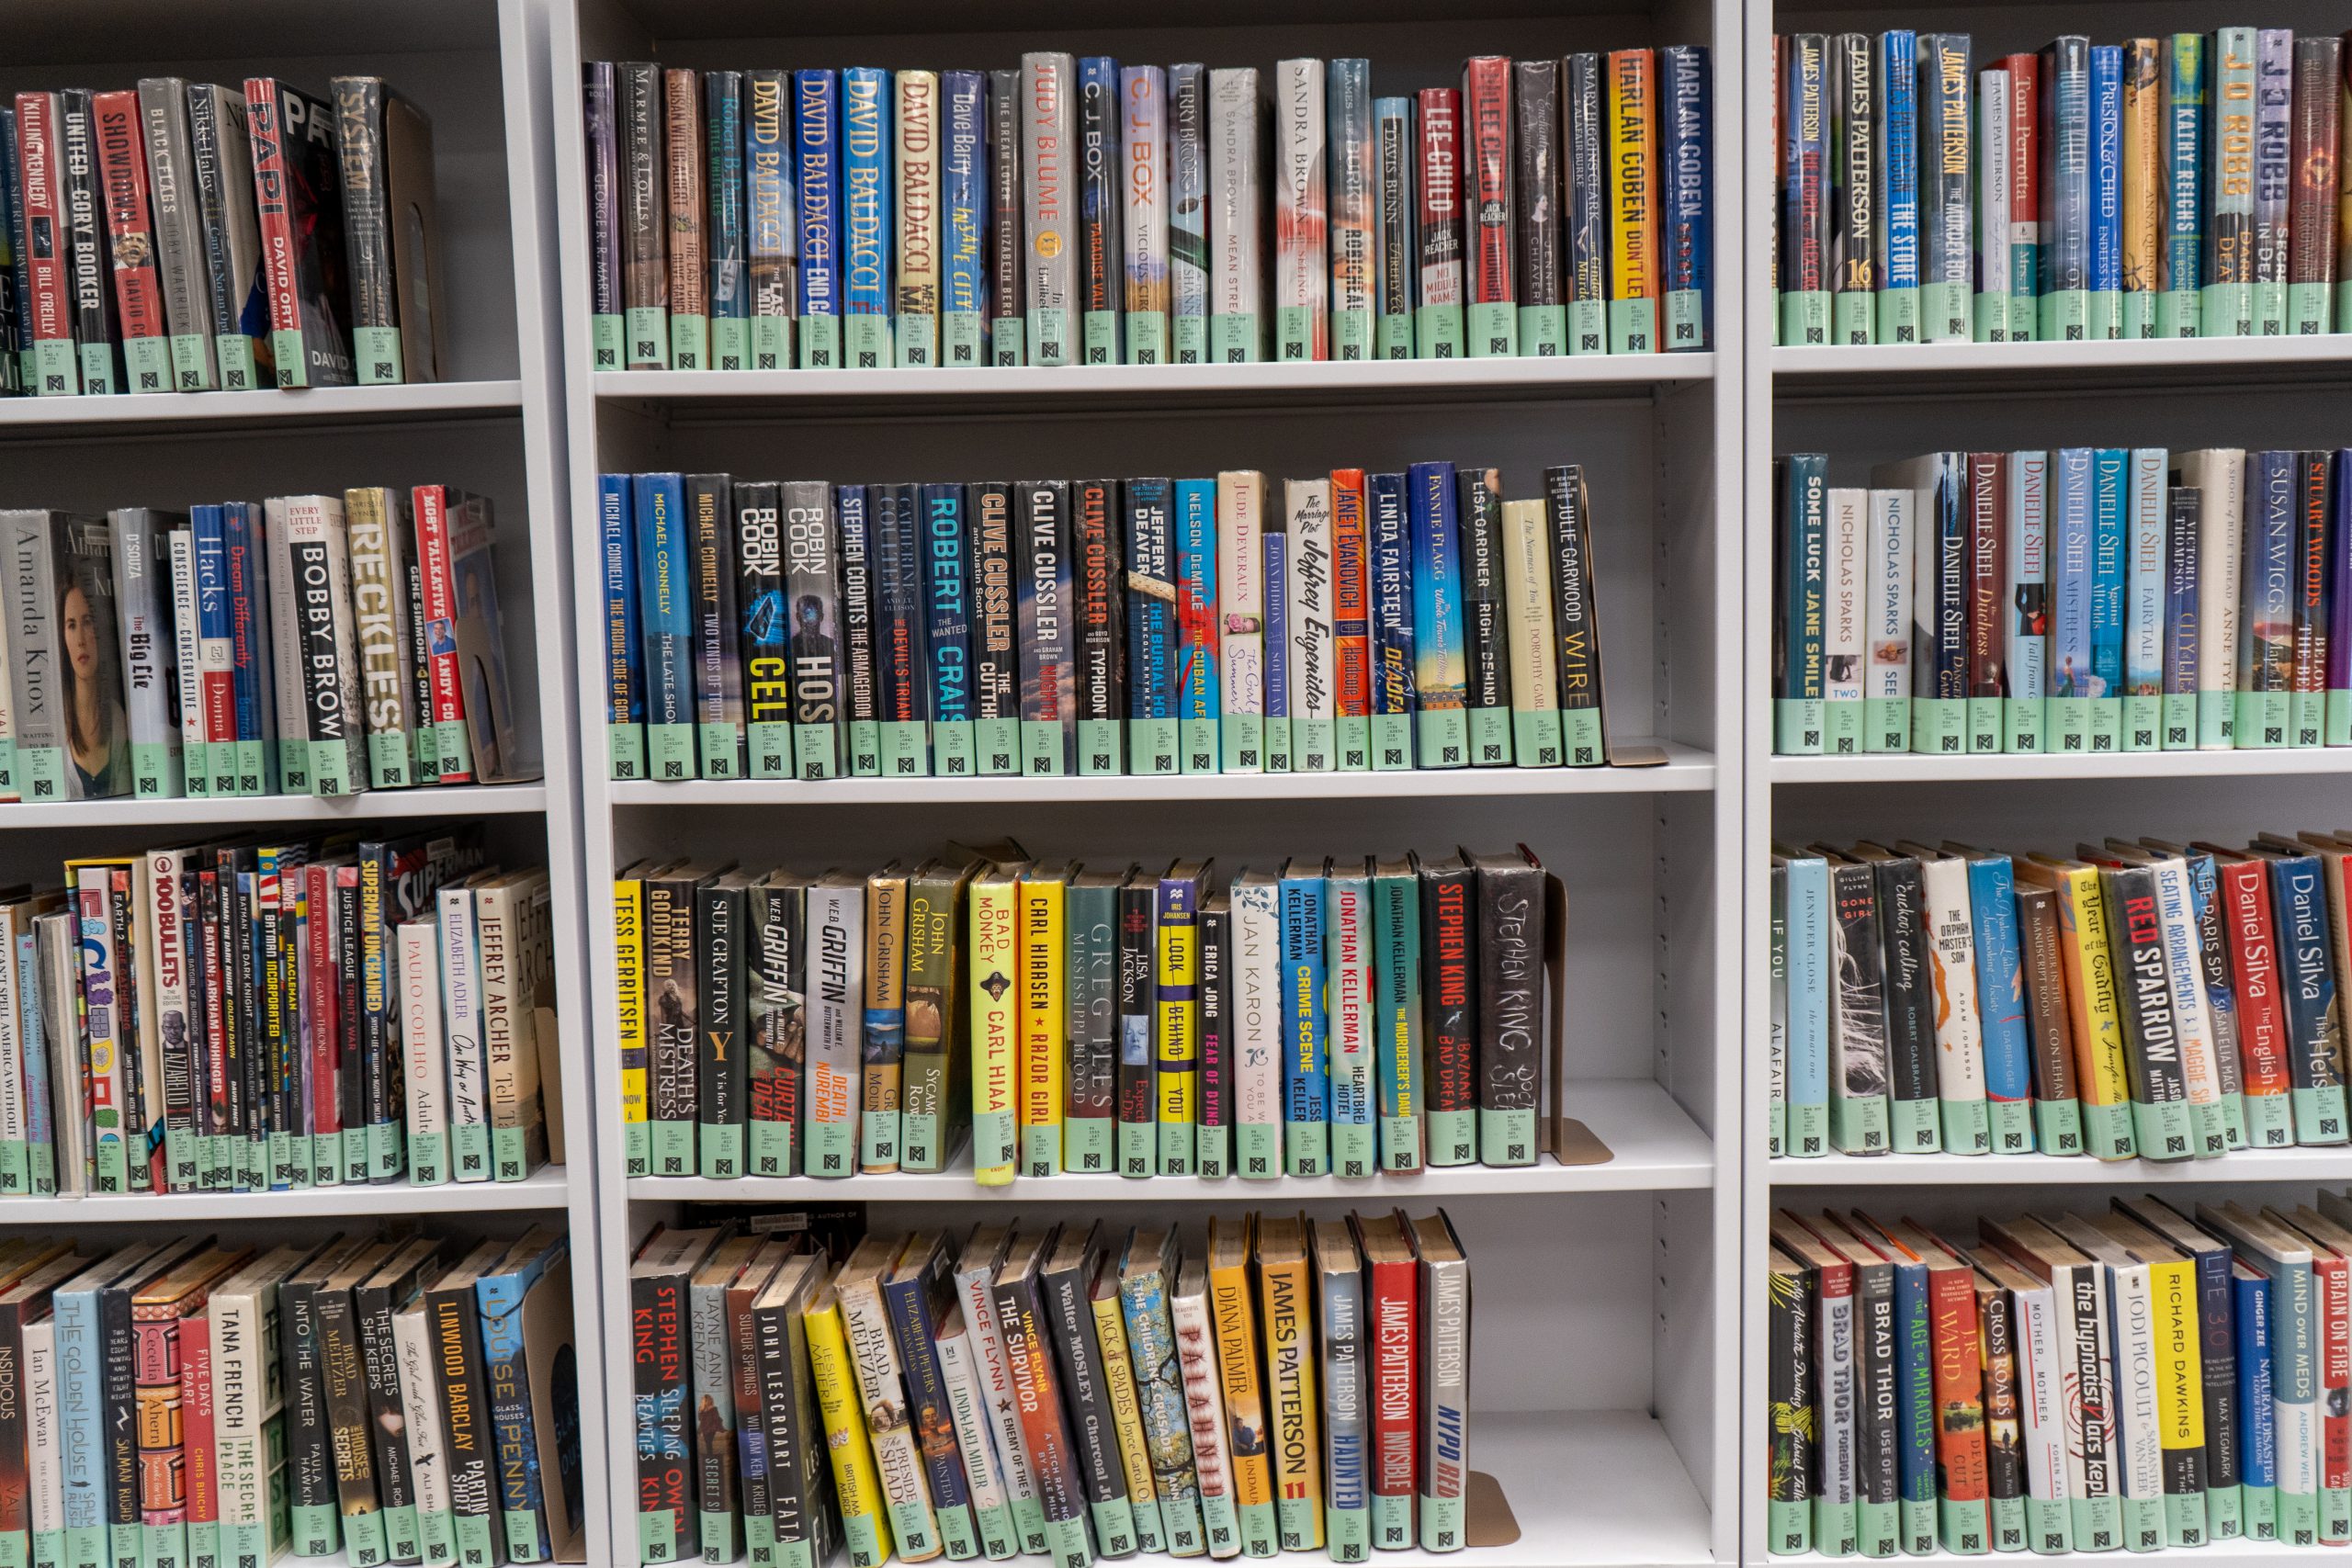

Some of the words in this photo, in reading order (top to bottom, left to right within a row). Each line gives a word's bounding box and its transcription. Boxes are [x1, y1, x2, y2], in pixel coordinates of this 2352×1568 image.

[1035, 64, 1057, 128] JUDY
[1131, 78, 1149, 107] C.
[1942, 48, 1966, 96] JAMES
[2015, 76, 2030, 111] Tom
[849, 81, 878, 157] DAVID
[1131, 117, 1151, 133] J.
[1426, 108, 1452, 142] LEE
[1619, 57, 1644, 142] HARLAN
[65, 112, 88, 175] UNITED
[151, 108, 167, 158] BLACK
[248, 102, 285, 213] PAPI
[1226, 110, 1236, 165] SANDRA
[1944, 100, 1966, 175] PATTERSON
[2177, 108, 2195, 163] KATHY
[103, 112, 137, 223] SHOWDOWN
[1036, 137, 1057, 220] BLUME
[1132, 141, 1152, 207] BOX
[1428, 151, 1453, 212] CHILD
[1621, 151, 1645, 222] COBEN
[2016, 122, 2030, 200] Perrotta
[73, 190, 92, 234] CORY
[156, 166, 175, 213] FLAGS
[594, 174, 605, 226] GEORGE
[1227, 170, 1237, 217] BROWN
[1893, 202, 1915, 229] THE
[2177, 171, 2195, 231] REICHS
[595, 232, 605, 242] R.
[596, 247, 606, 257] R.
[849, 166, 879, 292] BALDACCI
[1001, 220, 1012, 273] ELIZABETH
[1425, 241, 1459, 255] REACHER
[1430, 230, 1452, 243] JACK
[76, 243, 99, 309] BOOKER
[1437, 270, 1450, 281] NO
[1848, 259, 1871, 283] 16
[1892, 236, 1916, 282] STORE
[597, 262, 609, 312] MARTIN
[1002, 276, 1012, 317] BERG
[1426, 281, 1457, 294] MIDDLE
[1430, 292, 1456, 303] NAME
[289, 506, 320, 514] EVERY
[289, 517, 322, 525] LITTLE
[654, 493, 665, 547] MICHAEL
[1033, 491, 1055, 547] CLIVE
[1380, 494, 1397, 543] LINDA
[1807, 476, 1821, 526] SOME
[2025, 460, 2043, 531] DANIELLE
[2270, 468, 2287, 536] SUSAN
[296, 526, 318, 535] STEP
[741, 508, 763, 577] COOK
[759, 508, 779, 575] ROBIN
[1136, 509, 1150, 575] DEAVER
[1150, 506, 1165, 577] JEFFERY
[1558, 504, 1577, 543] JULIE
[1888, 498, 1900, 580] NICHOLAS
[16, 527, 45, 637] Amanda
[128, 533, 142, 579] D'SOUZA
[198, 536, 224, 613] Hacks
[931, 498, 960, 614] ROBERT
[1806, 532, 1820, 582] LUCK
[2025, 534, 2043, 577] STEEL
[2268, 544, 2286, 615] WIGGS
[302, 547, 332, 642] BOBBY
[658, 551, 671, 615] CONNELLY
[1035, 553, 1057, 641] CUSSLER
[1382, 548, 1401, 628] FAIRSTEIN
[1561, 548, 1581, 622] GARWOOD
[1886, 583, 1900, 636] SPARKS
[932, 625, 967, 637] WANTED
[937, 618, 952, 626] THE
[1806, 591, 1820, 637] JANE
[25, 648, 49, 715] Knox
[1565, 631, 1590, 706] WIRE
[1833, 689, 1858, 697] TWO
[155, 875, 173, 908] 100
[362, 860, 379, 928] SUPERMAN
[616, 895, 634, 938] TESS
[1031, 898, 1047, 936] CARL
[1840, 897, 1873, 907] GONE
[1844, 909, 1873, 919] GIRL
[1949, 910, 1962, 921] THE
[2238, 874, 2265, 942] Daniel
[712, 901, 728, 938] SUE
[978, 897, 994, 964] MONKEY
[996, 909, 1010, 951] BAD
[1439, 884, 1464, 960] STEPHEN
[1939, 937, 1973, 949] MASTER'S
[1940, 924, 1969, 935] ORPHAN
[2125, 897, 2158, 943] RED
[157, 910, 180, 987] BULLETS
[363, 928, 383, 1012] UNCHAINED
[408, 941, 423, 998] PAULO
[480, 918, 505, 990] JEFFREY
[1168, 938, 1184, 972] LOOK
[1951, 952, 1965, 964] SON
[2246, 941, 2269, 998] Silva
[618, 944, 638, 1039] GERRITSEN
[712, 941, 729, 1025] GRAFTON
[1031, 944, 1049, 1010] HIAASEN
[1297, 965, 1312, 1019] CRIME
[1441, 964, 1465, 1006] KING
[488, 994, 511, 1064] ARCHER
[1168, 1006, 1184, 1055] BEHIND
[2134, 948, 2177, 1063] SPARROW
[412, 1003, 428, 1079] COELHO
[1031, 1033, 1048, 1084] RAZOR
[1298, 1021, 1313, 1073] SCENE
[1031, 1092, 1048, 1124] GIRL
[1168, 1088, 1184, 1115] YOU
[295, 1300, 309, 1336] INTO
[1269, 1271, 1295, 1342] JAMES
[2168, 1274, 2187, 1353] RICHARD
[2293, 1269, 2308, 1314] MIND
[146, 1328, 160, 1381] Cecelia
[221, 1309, 239, 1354] TANA
[437, 1302, 465, 1376] LINWOOD
[635, 1309, 654, 1364] KING
[658, 1287, 678, 1381] STEPHEN
[762, 1315, 780, 1359] JOHN
[969, 1280, 990, 1330] VINCE
[983, 1337, 1004, 1392] FLYNN
[1059, 1282, 1077, 1332] Walter
[1069, 1337, 1093, 1402] MOSLEY
[1874, 1302, 1891, 1358] BRAD
[1990, 1300, 2007, 1355] CROSS
[2295, 1317, 2308, 1350] OVER
[33, 1348, 47, 1376] Ian
[298, 1341, 311, 1370] THE
[2295, 1354, 2311, 1398] MEDS
[34, 1380, 50, 1447] McEwan
[225, 1359, 243, 1427] FRENCH
[300, 1379, 314, 1427] WATER
[1278, 1348, 1306, 1474] PATTERSON
[1877, 1364, 1893, 1420] THOR
[1993, 1359, 2011, 1416] ROADS
[2174, 1360, 2189, 1438] DAWKINS
[148, 1399, 159, 1444] Ahern
[448, 1383, 474, 1451] BARCLAY
[767, 1371, 790, 1470] LESCROART
[1385, 1431, 1411, 1490] INVISIBLE
